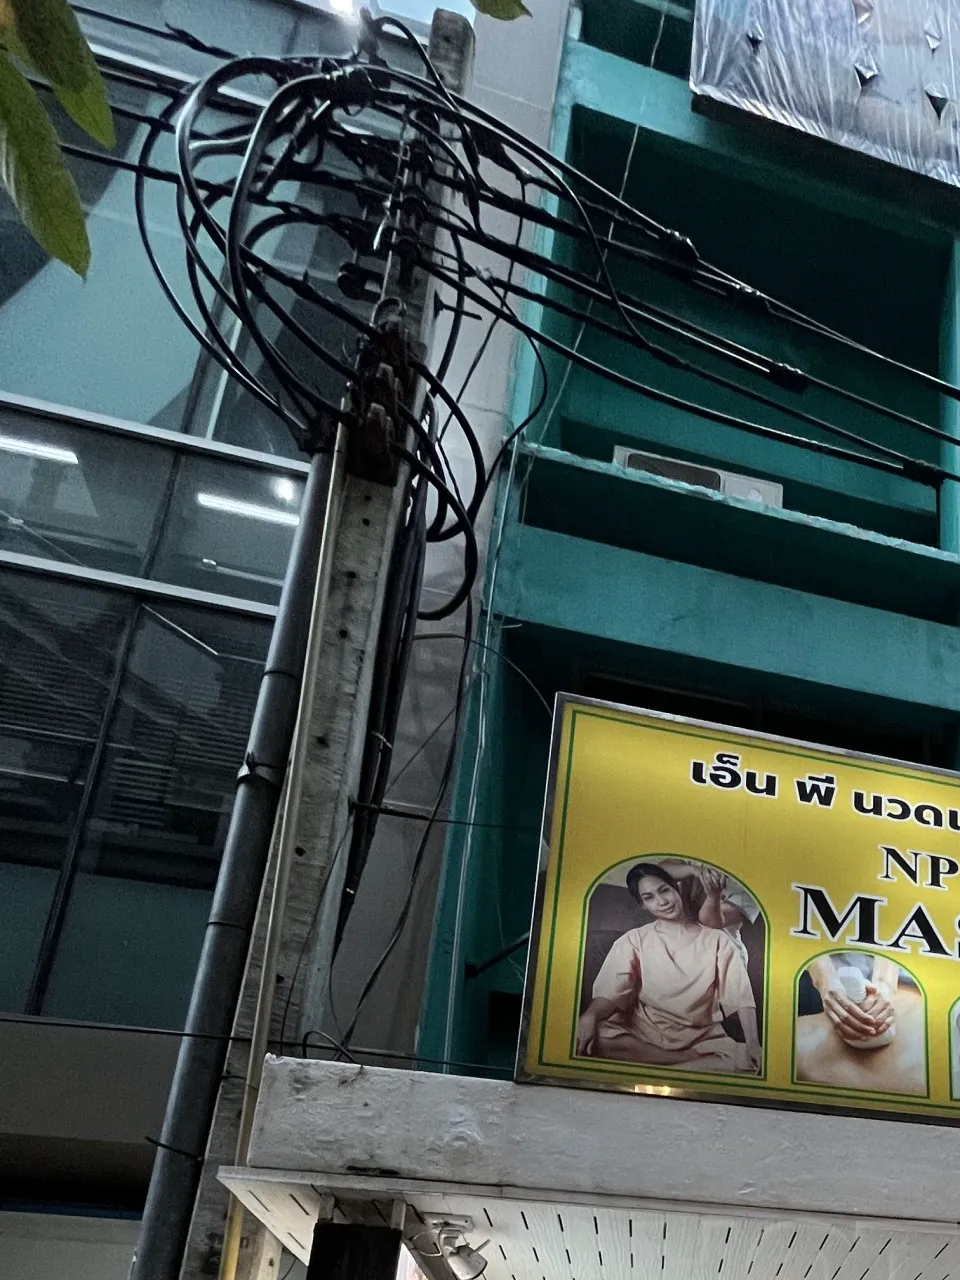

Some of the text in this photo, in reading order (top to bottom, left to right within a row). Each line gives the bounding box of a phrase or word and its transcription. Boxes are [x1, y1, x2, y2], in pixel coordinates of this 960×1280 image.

[690, 753, 776, 799] เอ็น
[796, 772, 836, 808] พี
[880, 845, 960, 891] NP
